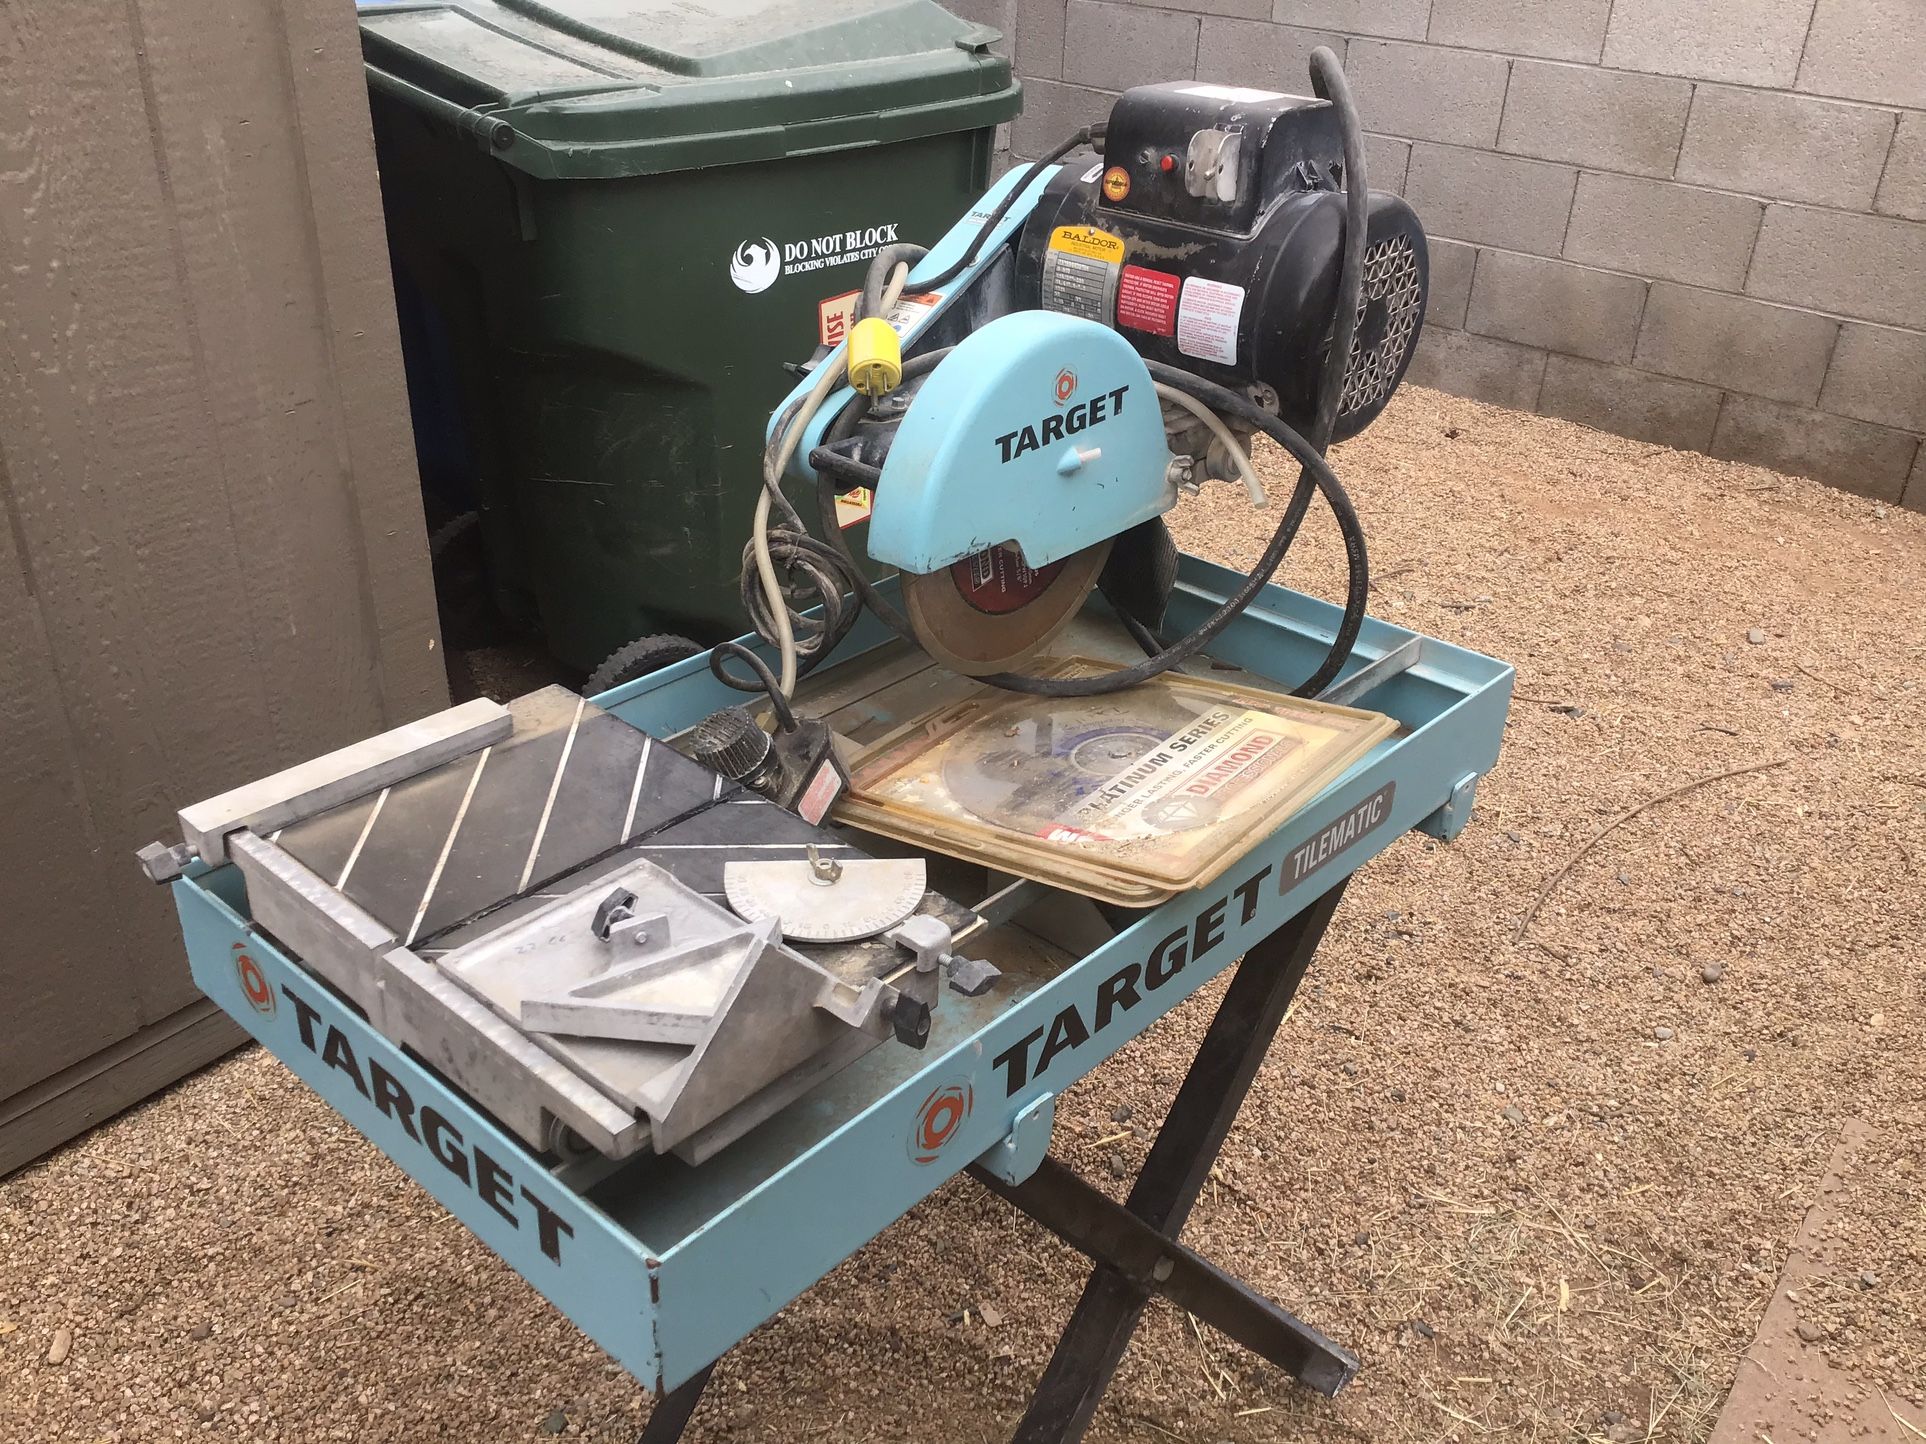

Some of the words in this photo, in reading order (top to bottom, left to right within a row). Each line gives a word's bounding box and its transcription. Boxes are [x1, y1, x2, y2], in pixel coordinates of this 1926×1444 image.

[785, 241, 809, 262] DO
[811, 234, 843, 257] NOT
[845, 223, 899, 250] BLOCK
[971, 211, 1011, 222] TART
[1062, 231, 1117, 250] BALDOR
[784, 257, 824, 275] BLOCKING
[825, 251, 860, 267] VIOLATES
[860, 246, 878, 260] CITY
[995, 385, 1129, 464] TARGET
[1078, 752, 1173, 816] PLATINUM
[1169, 711, 1230, 752] SERIES
[1184, 743, 1218, 769] FASTER
[1216, 717, 1254, 745] CUTTING
[1187, 735, 1275, 795] DIAMOND
[1294, 794, 1383, 880] TILEMATIC
[992, 864, 1272, 1098] TARGET
[281, 983, 575, 1267] TARGET
